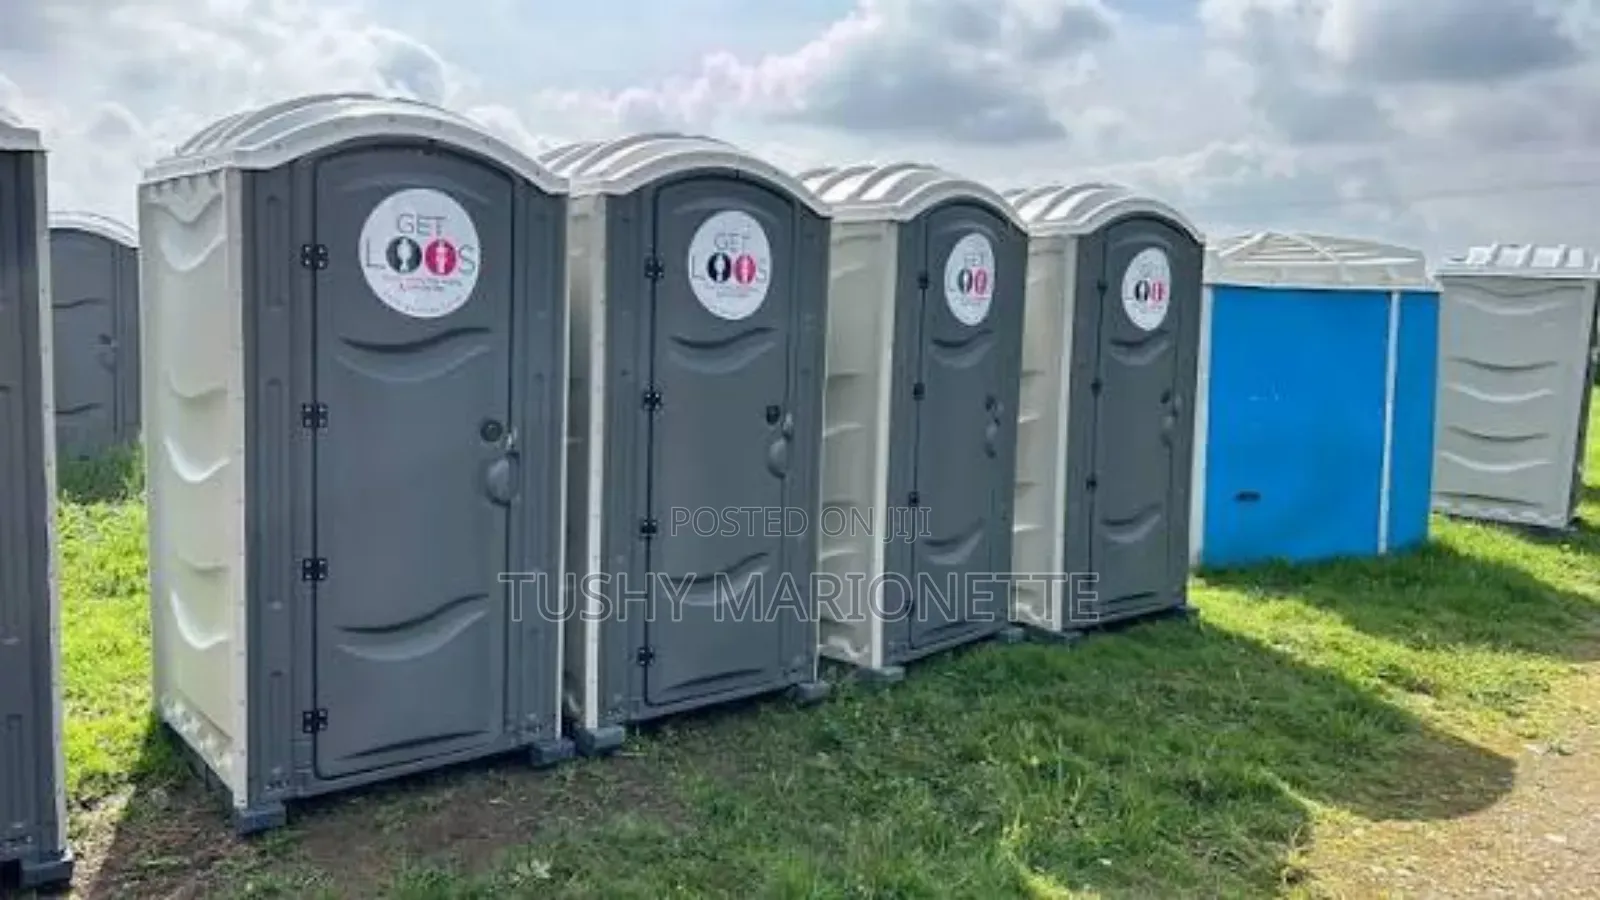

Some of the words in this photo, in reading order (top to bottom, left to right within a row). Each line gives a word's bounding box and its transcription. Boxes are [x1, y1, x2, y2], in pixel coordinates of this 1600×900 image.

[396, 213, 446, 236] GET
[714, 232, 752, 254] GET
[365, 236, 476, 275] LOOS
